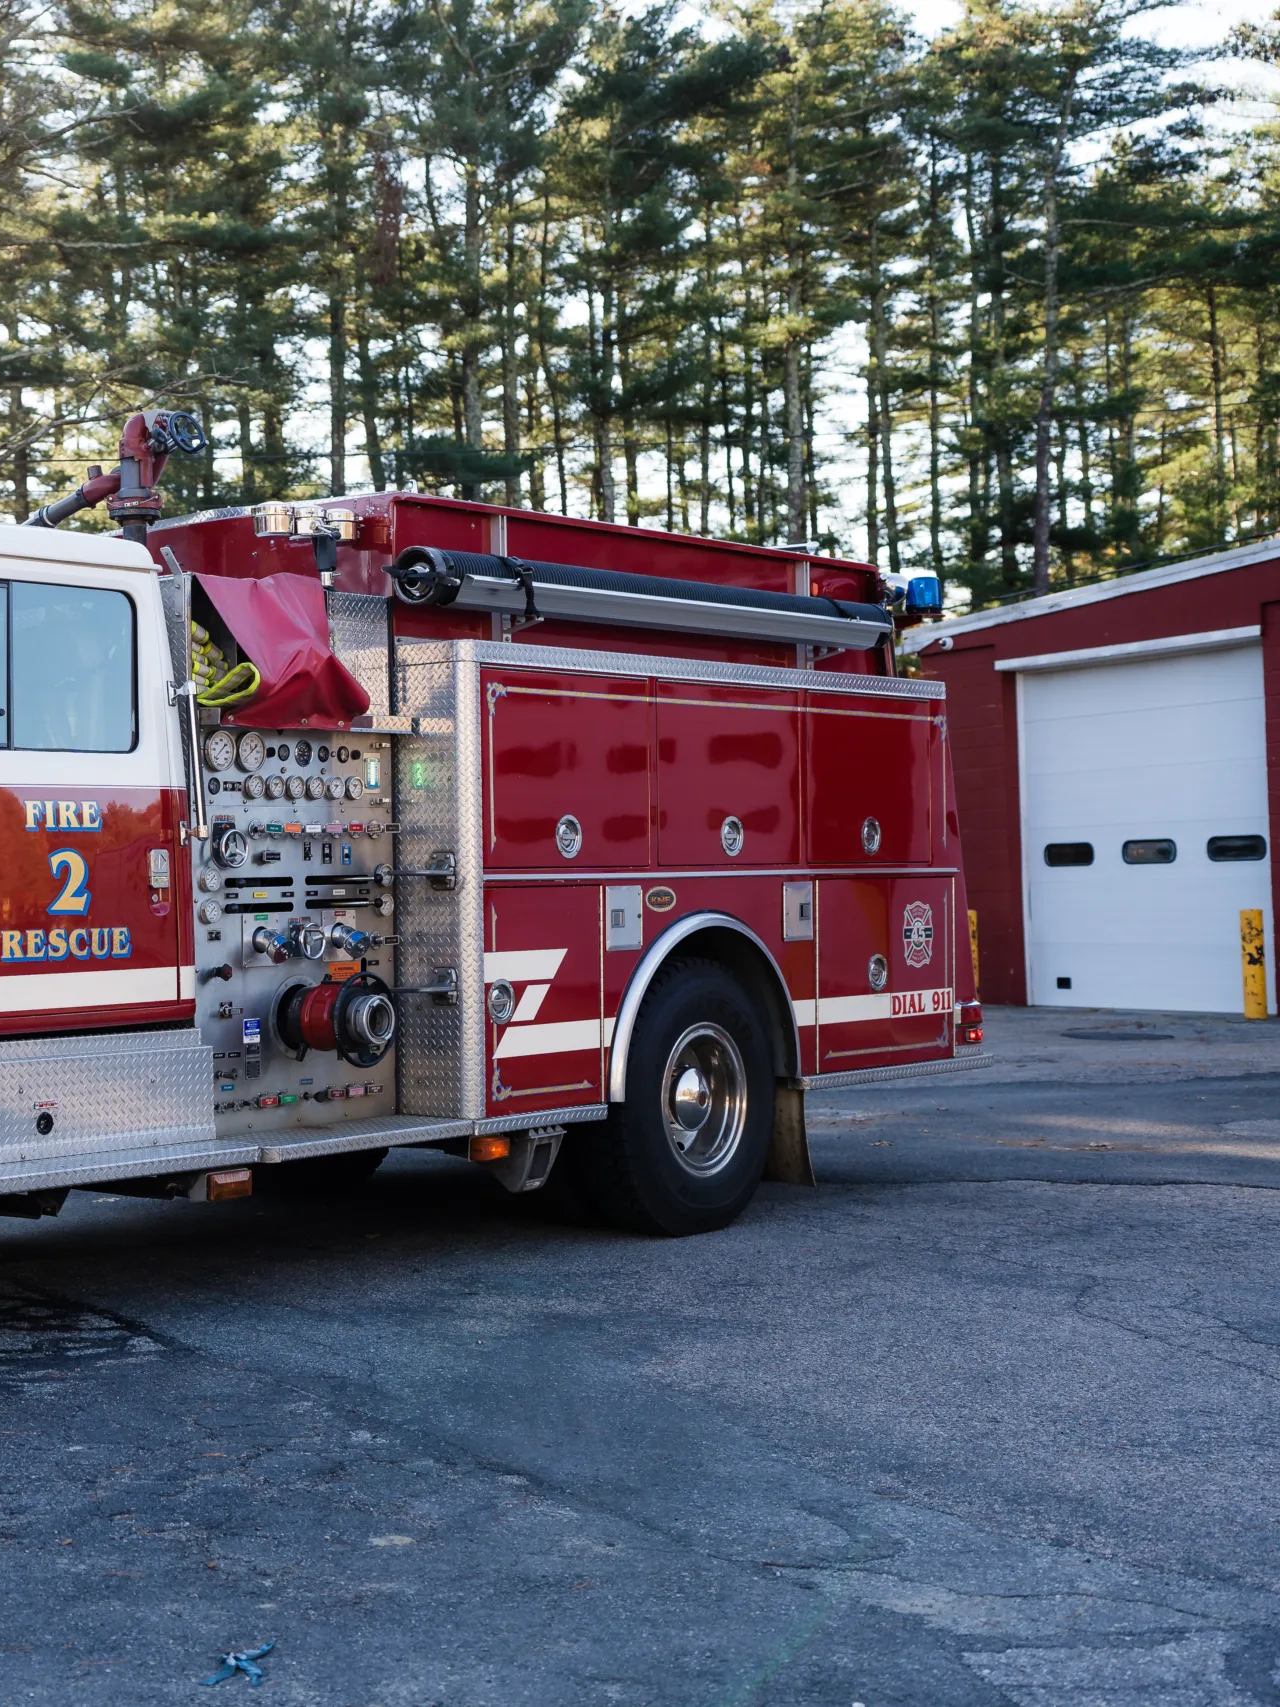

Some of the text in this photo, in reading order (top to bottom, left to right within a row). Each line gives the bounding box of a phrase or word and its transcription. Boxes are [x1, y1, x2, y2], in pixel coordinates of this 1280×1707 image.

[24, 800, 102, 832] FIRE
[46, 848, 92, 916] 2
[651, 896, 670, 904] KME
[0, 926, 132, 962] RESCUE
[911, 926, 926, 941] 45
[891, 990, 952, 1016] DIAL 911
